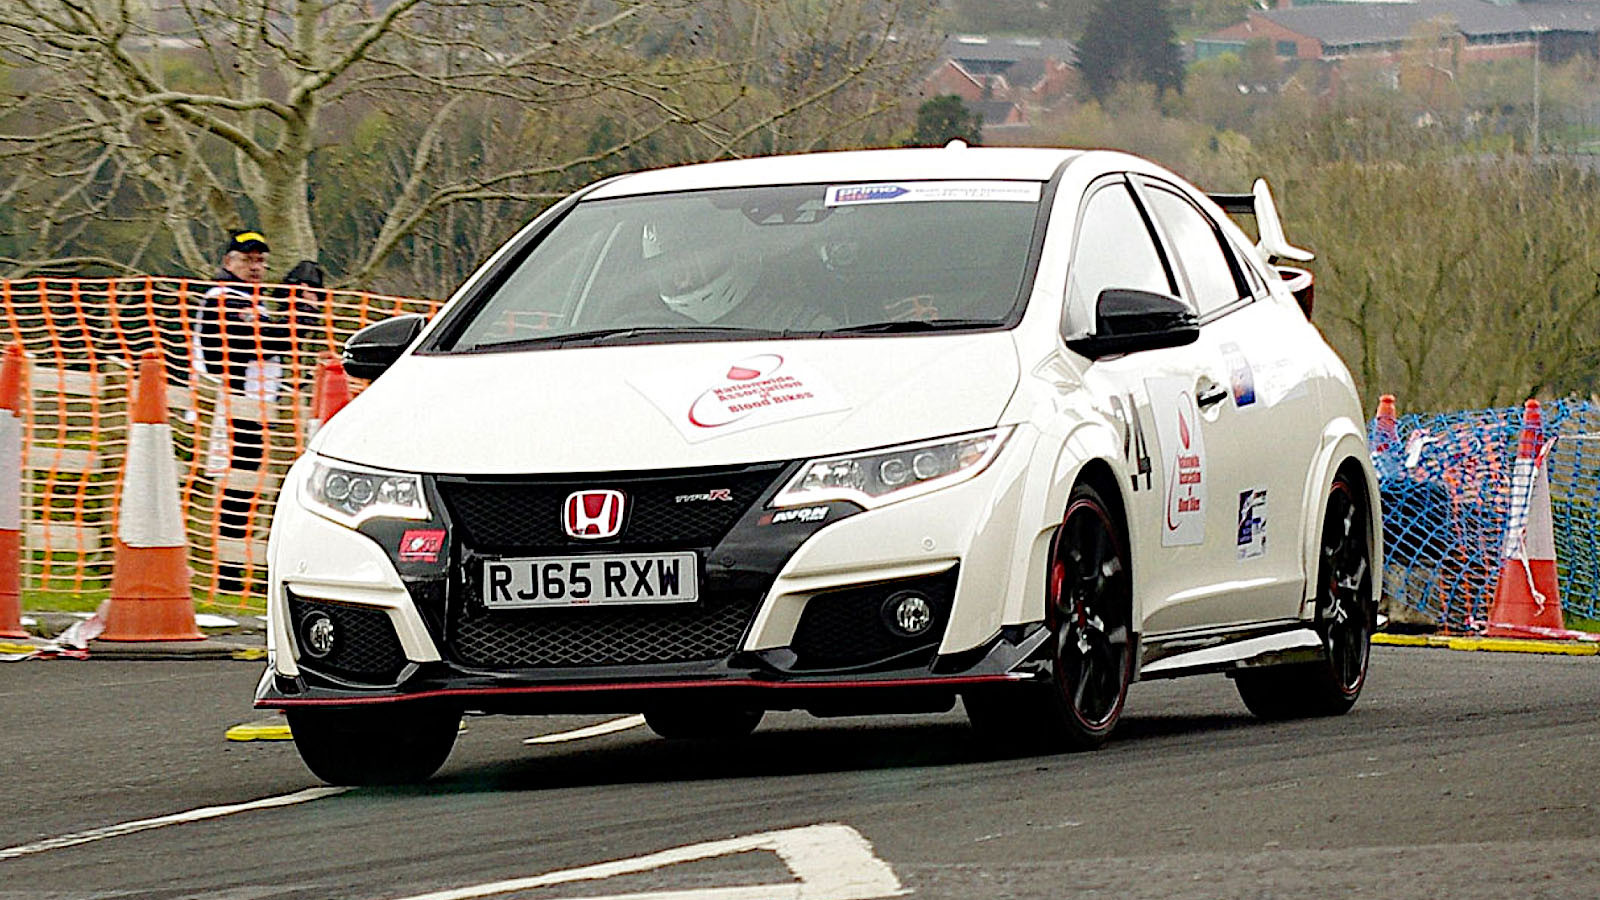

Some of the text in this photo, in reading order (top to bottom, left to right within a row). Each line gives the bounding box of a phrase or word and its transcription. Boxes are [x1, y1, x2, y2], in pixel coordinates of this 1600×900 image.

[713, 376, 794, 394] Nationwide
[718, 381, 802, 401] Association
[728, 391, 814, 413] Blood Bikes
[772, 506, 830, 523] AVON
[489, 559, 680, 602] RJ65 RXW
